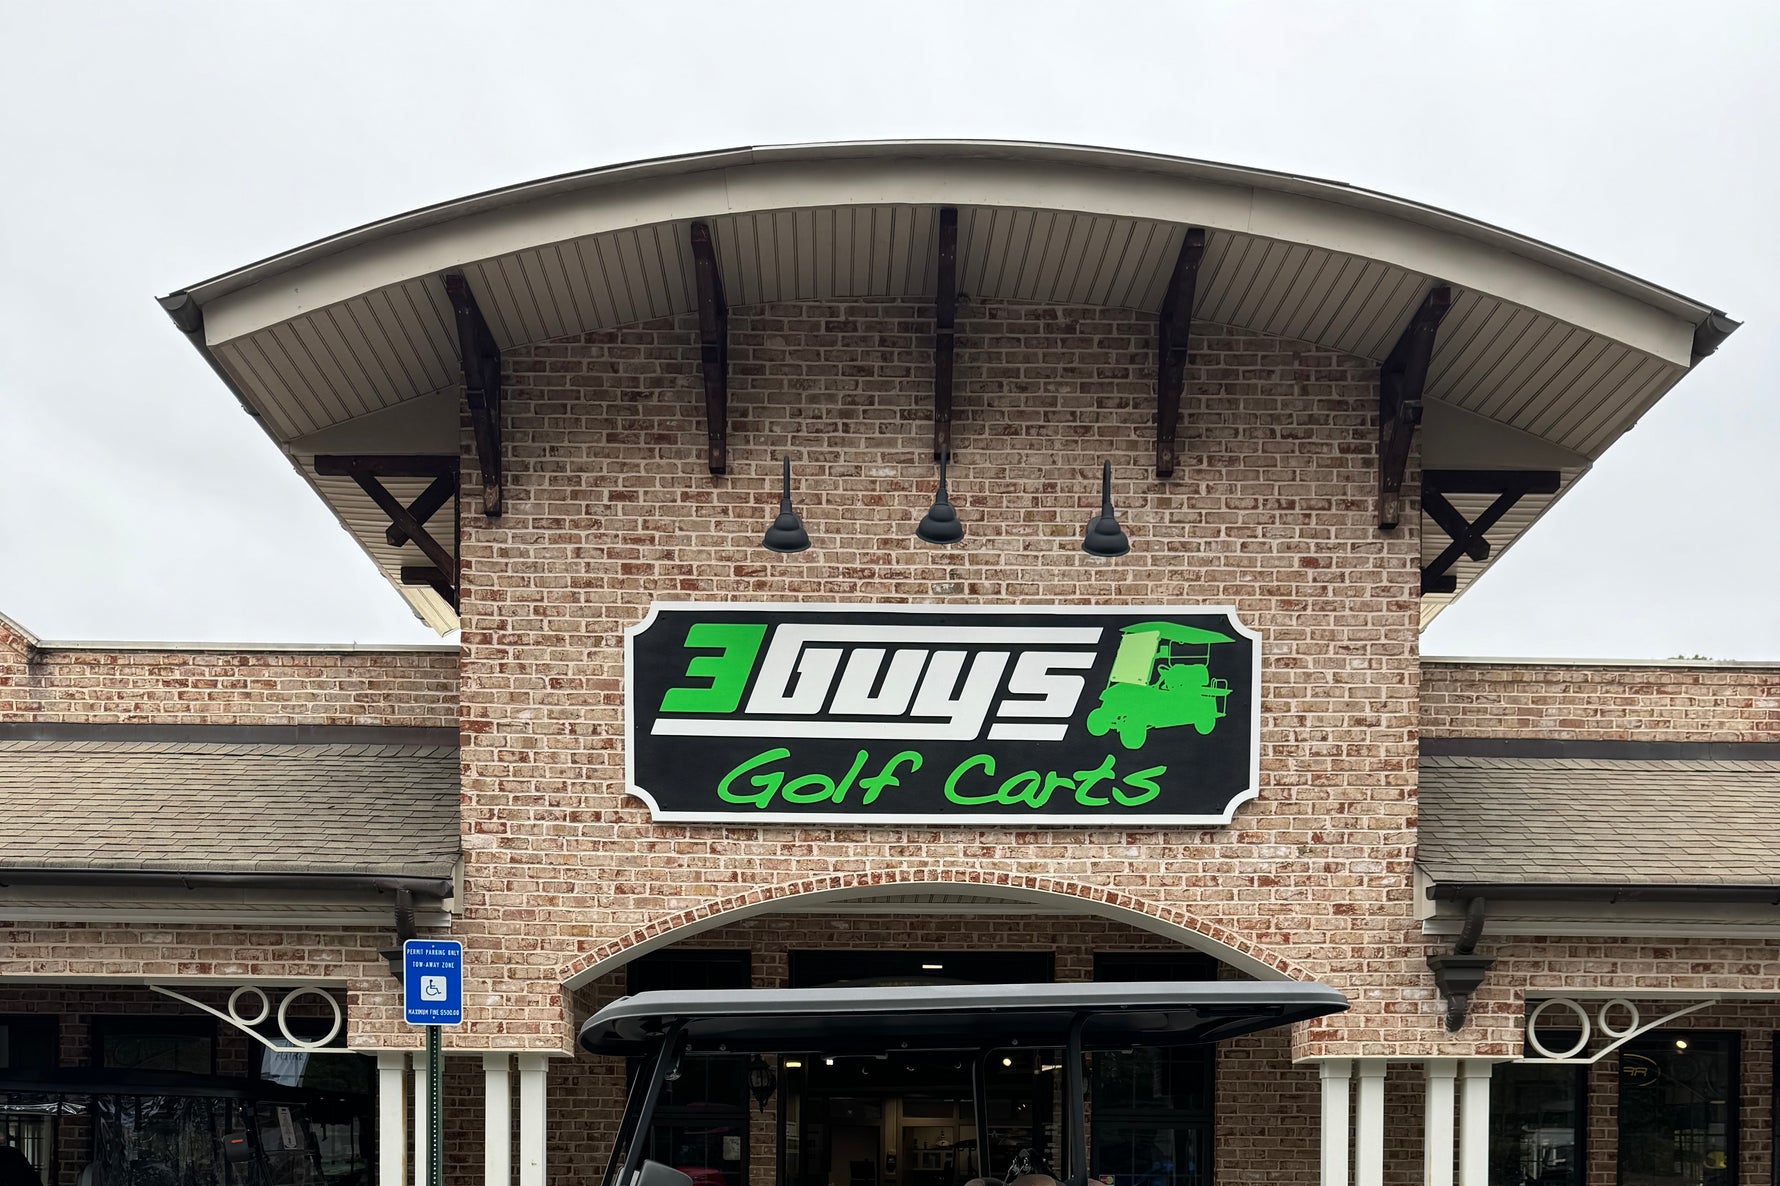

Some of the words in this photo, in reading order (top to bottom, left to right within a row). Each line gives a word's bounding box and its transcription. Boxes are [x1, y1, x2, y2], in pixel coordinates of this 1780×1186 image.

[659, 623, 768, 713] 3
[717, 747, 923, 809] Golf
[944, 754, 1167, 808] Carts
